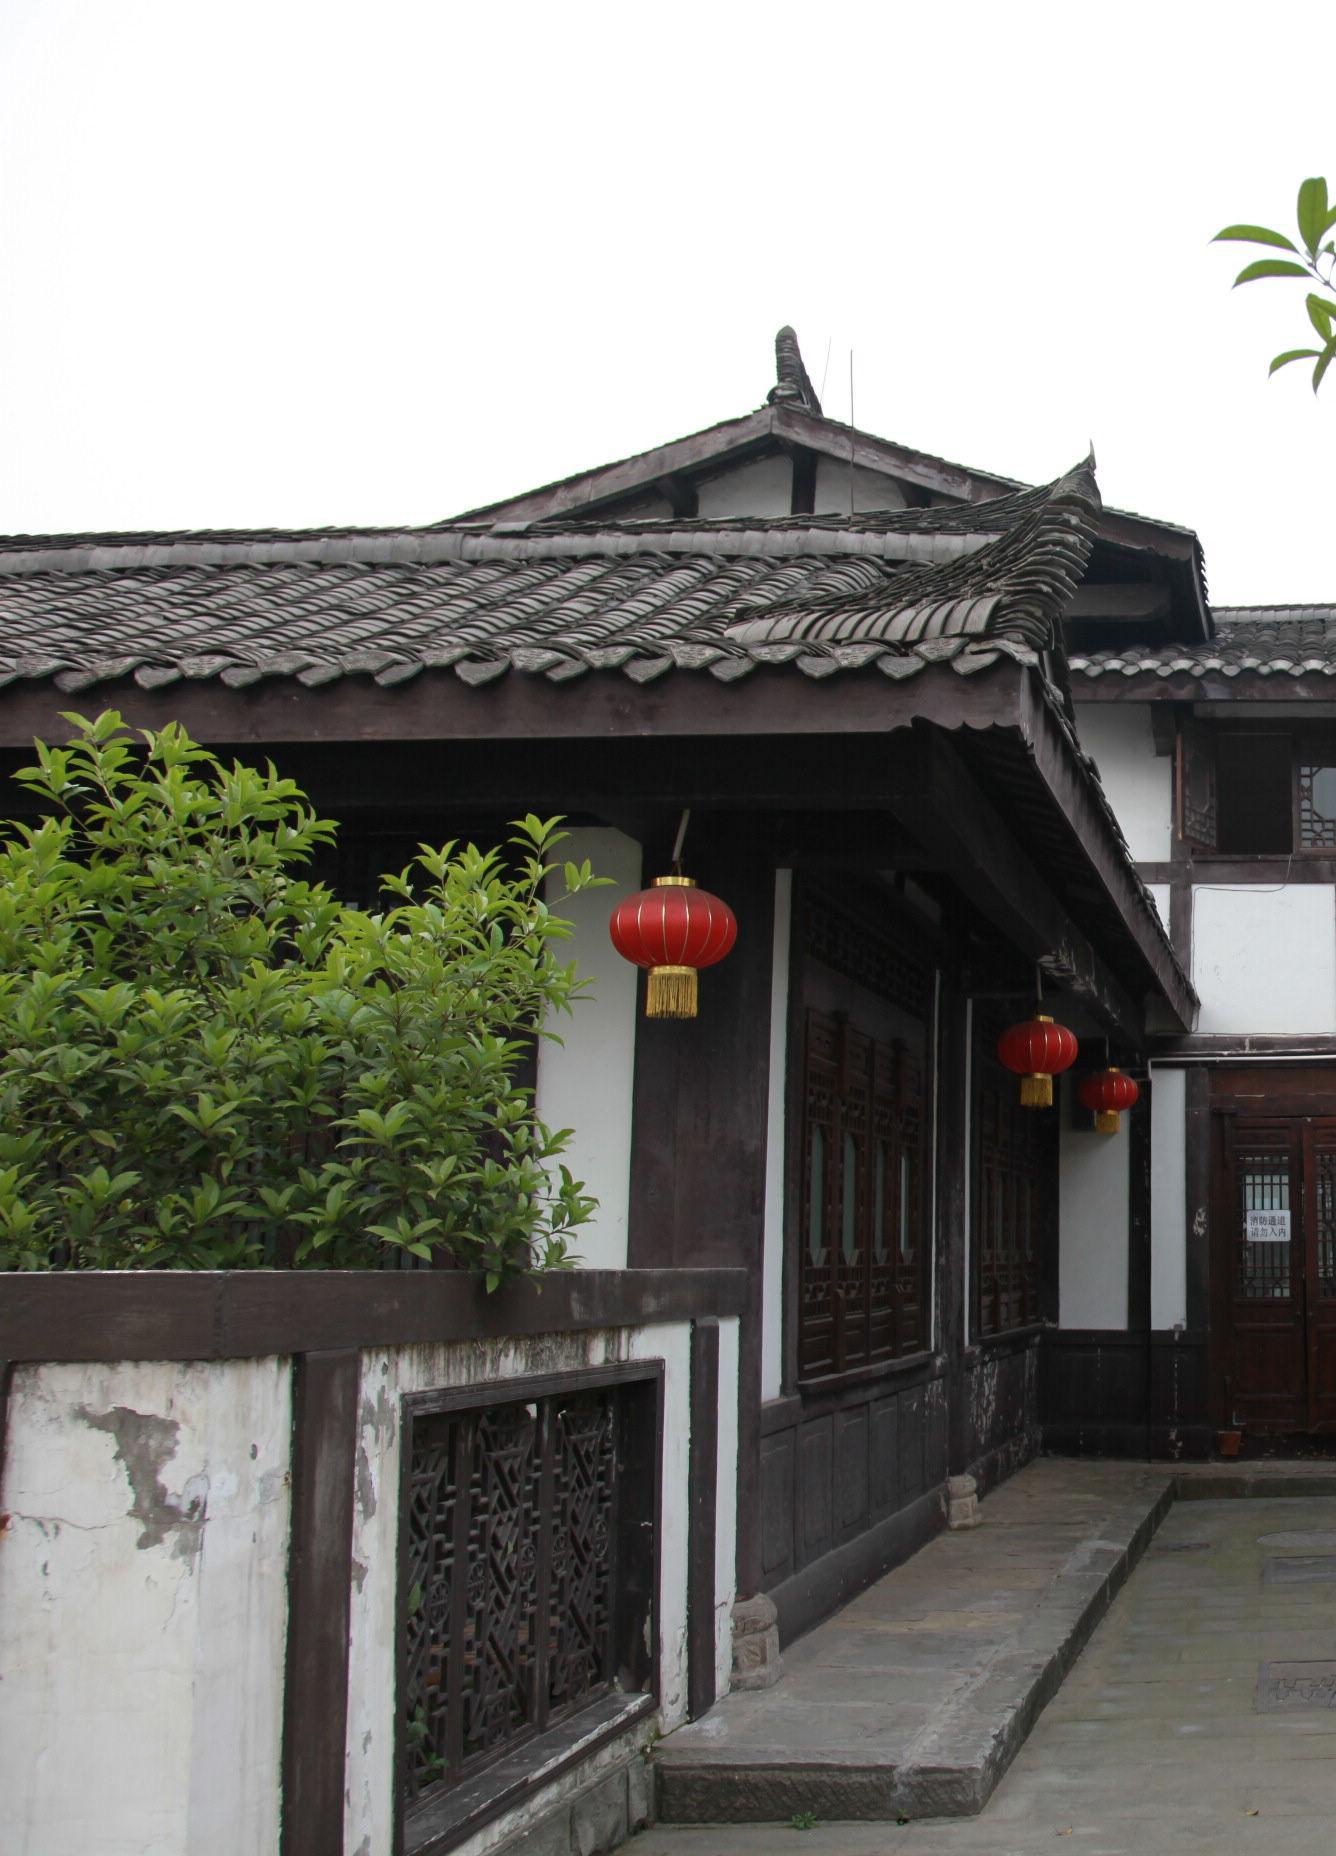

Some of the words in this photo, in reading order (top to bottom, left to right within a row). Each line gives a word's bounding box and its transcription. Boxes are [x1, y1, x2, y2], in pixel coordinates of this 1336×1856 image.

[1249, 1215, 1286, 1226] 消防通道
[1250, 1226, 1286, 1238] 请勿入内
